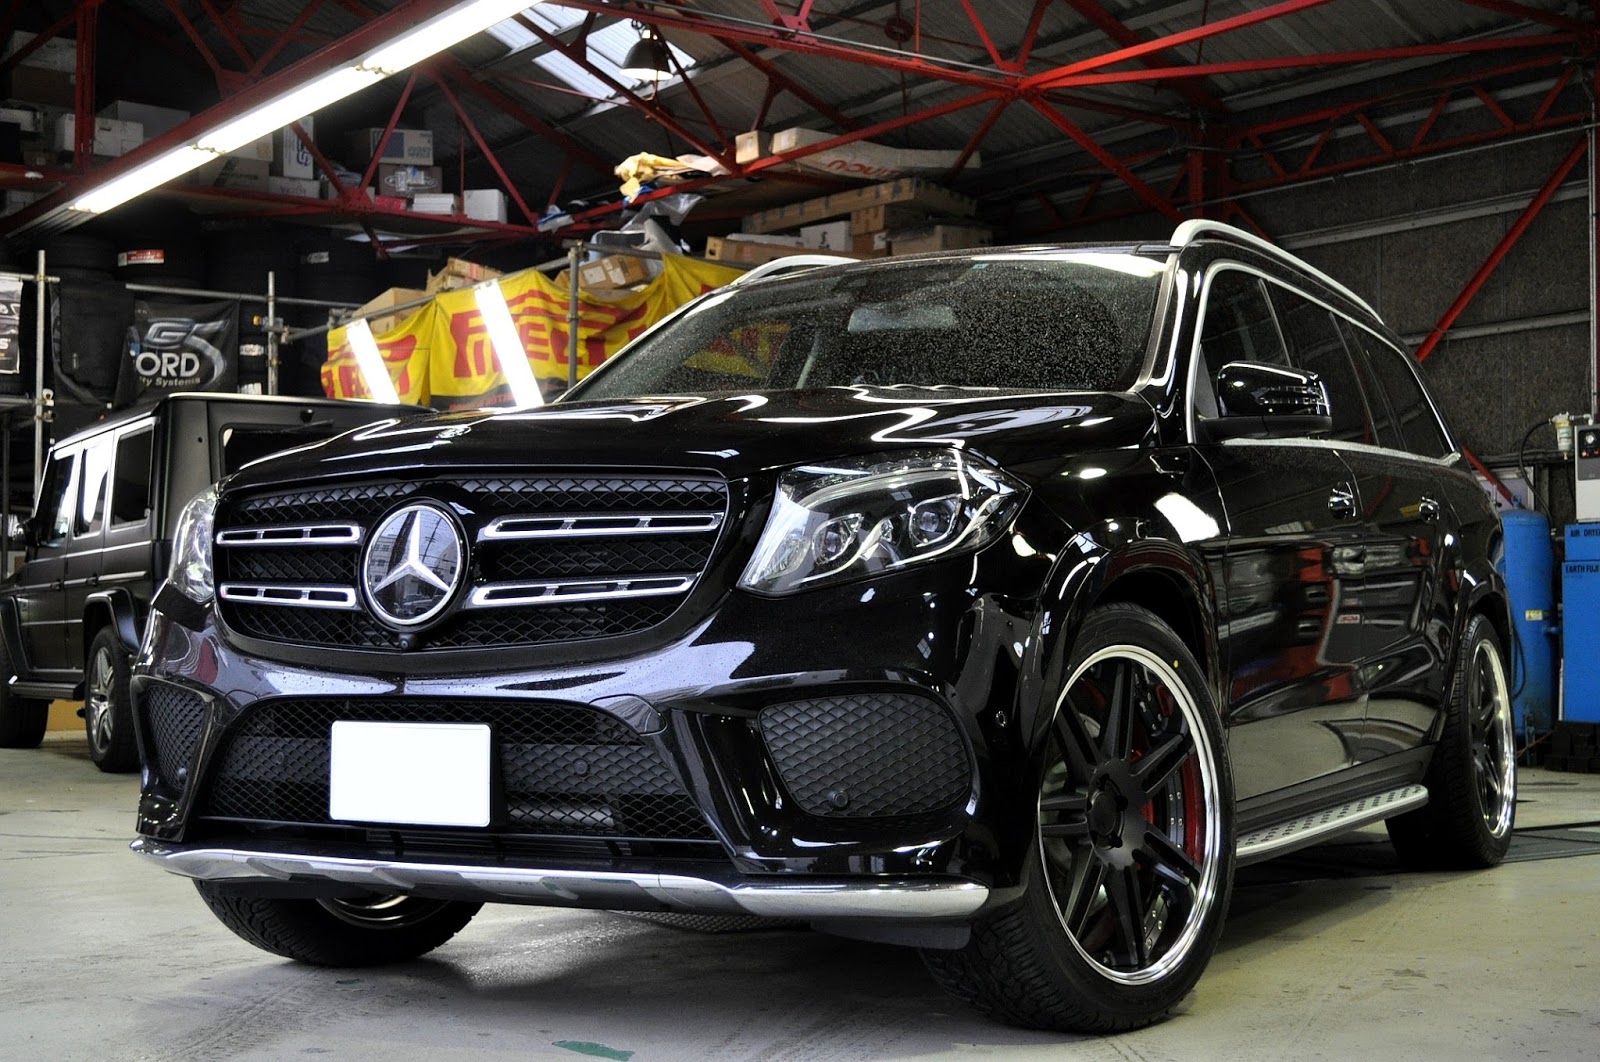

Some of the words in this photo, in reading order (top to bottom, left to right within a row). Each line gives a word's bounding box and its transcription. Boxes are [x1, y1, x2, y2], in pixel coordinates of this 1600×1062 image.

[1570, 529, 1581, 537] AIR
[1583, 529, 1600, 537] DRYE
[1565, 565, 1585, 573] EARTH
